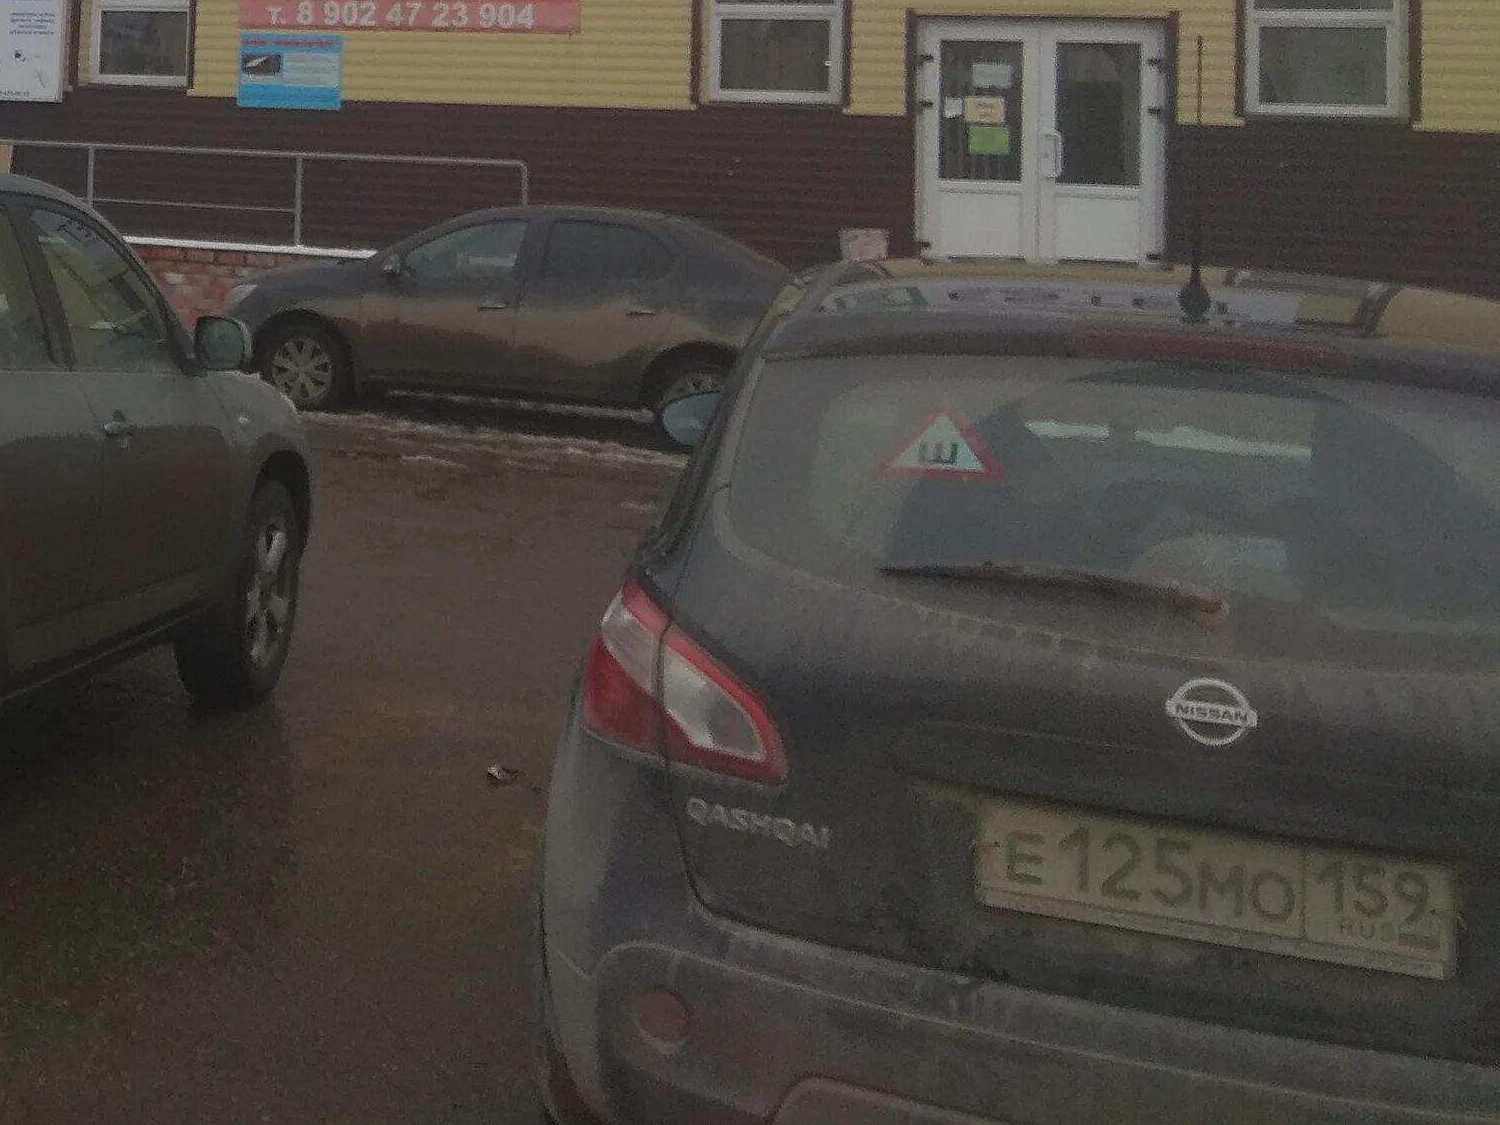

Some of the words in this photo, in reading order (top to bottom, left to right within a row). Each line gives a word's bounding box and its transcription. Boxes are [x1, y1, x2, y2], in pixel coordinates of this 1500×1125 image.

[267, 6, 286, 26] т.
[296, 0, 313, 26] 8
[323, 0, 377, 27] 902
[386, 2, 422, 27] 47
[432, 2, 468, 28] 23
[478, 2, 535, 29] 904
[1175, 703, 1248, 723] NISSAN
[685, 796, 831, 849] QASHQAI
[1317, 857, 1428, 927] 159
